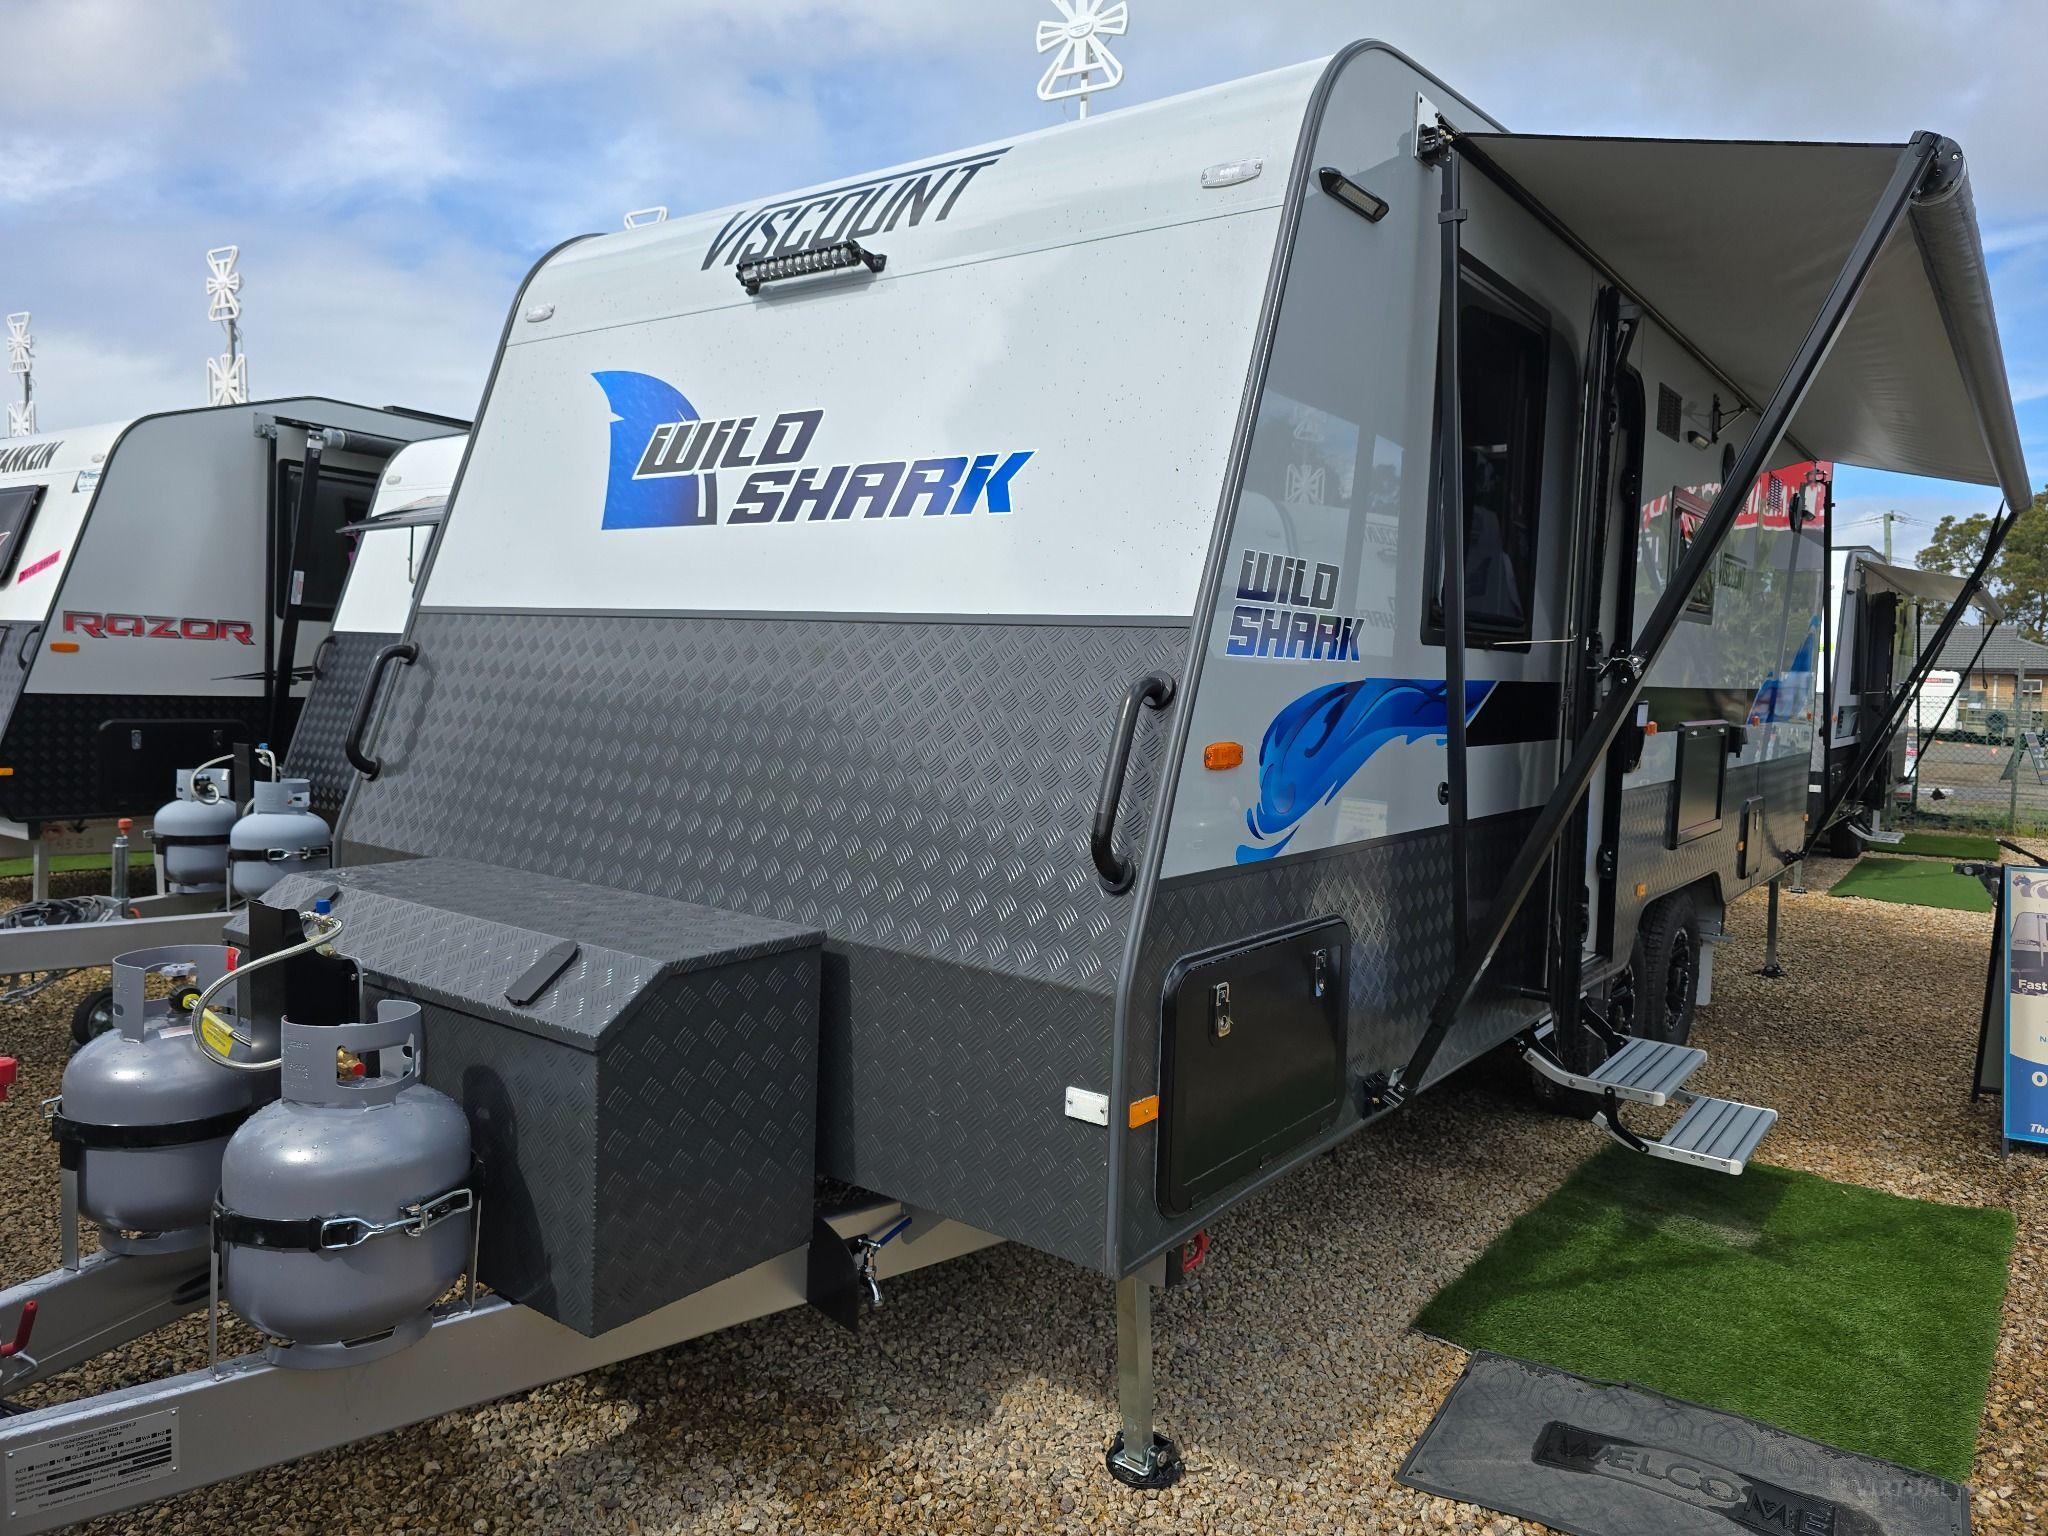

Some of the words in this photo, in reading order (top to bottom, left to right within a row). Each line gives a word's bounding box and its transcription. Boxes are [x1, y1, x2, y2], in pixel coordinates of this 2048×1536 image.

[701, 157, 1000, 271] VISCOUNT
[0, 440, 64, 473] ANKLIN
[633, 408, 826, 479] WILD
[725, 448, 1038, 526] SHARK
[1234, 548, 1341, 610] WILD
[62, 610, 256, 646] RAZOR
[1225, 605, 1367, 663] SHARK
[2018, 979, 2048, 991] Fast
